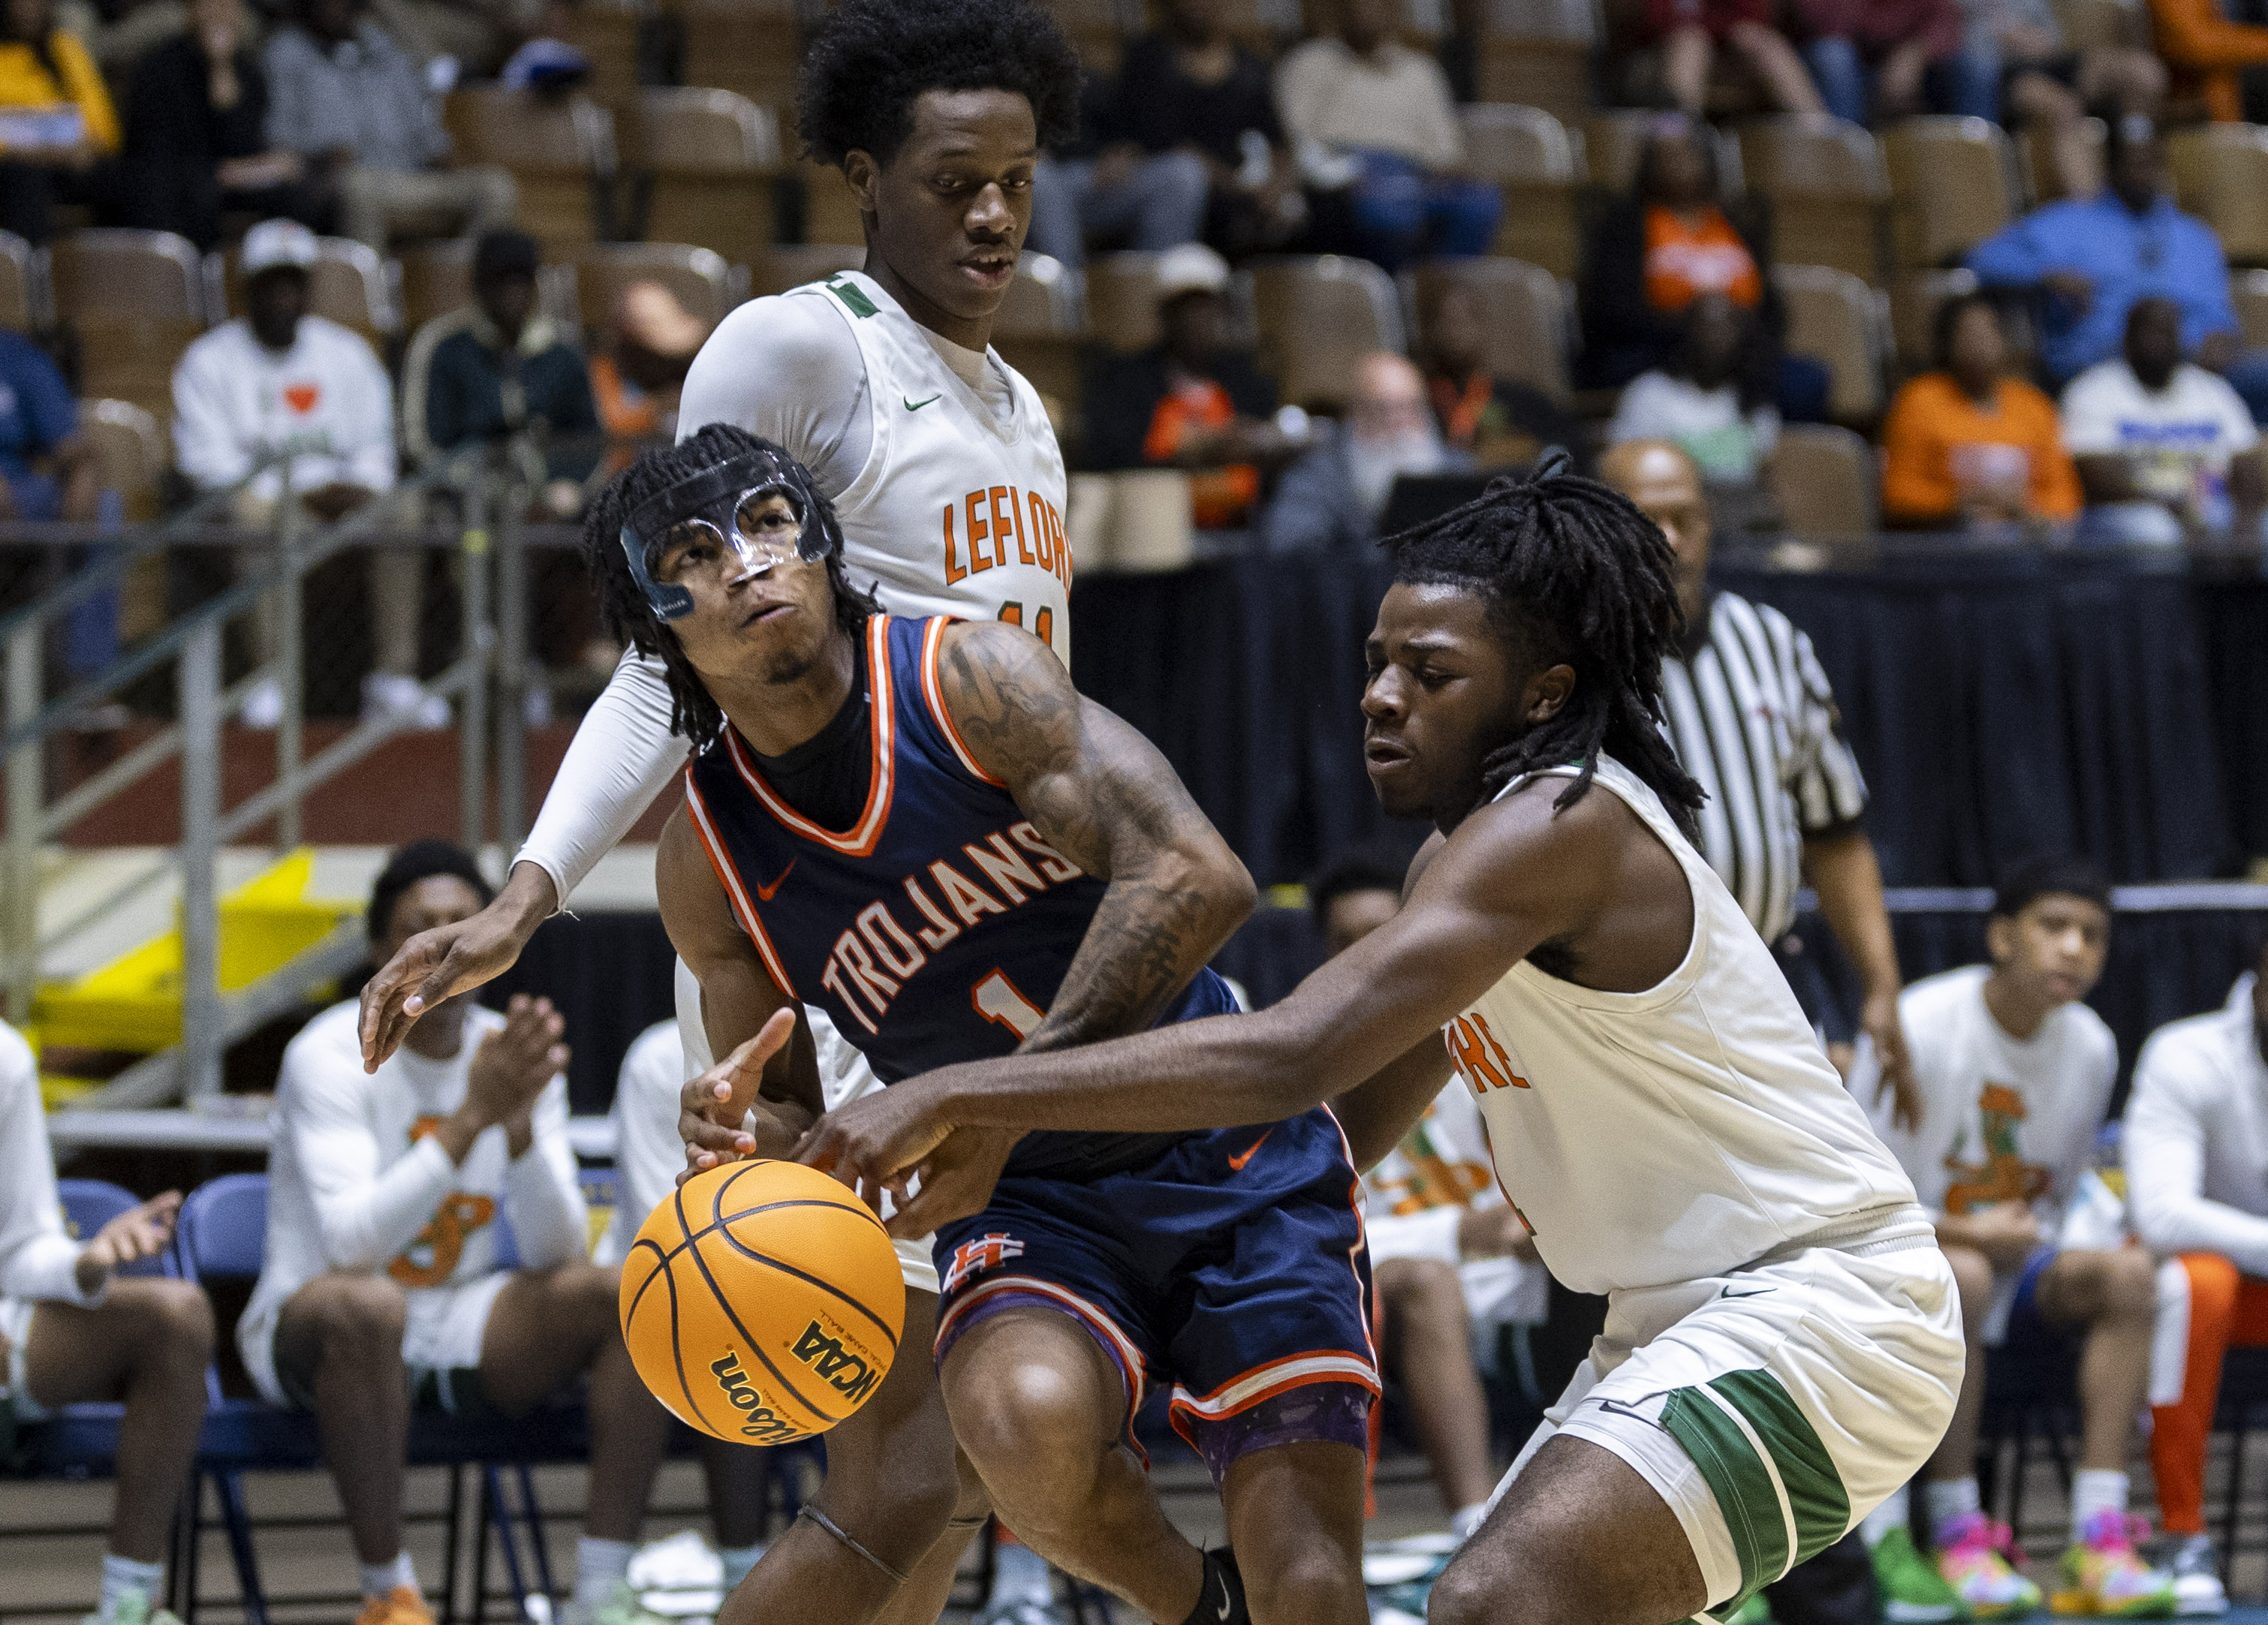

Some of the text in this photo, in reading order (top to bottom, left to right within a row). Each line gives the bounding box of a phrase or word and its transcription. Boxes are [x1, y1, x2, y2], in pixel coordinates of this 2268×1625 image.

[943, 485, 1073, 601] LEFLOR
[821, 821, 1083, 1036] TROJANS
[971, 967, 1047, 1043] 1
[790, 1318, 881, 1404] NCAA
